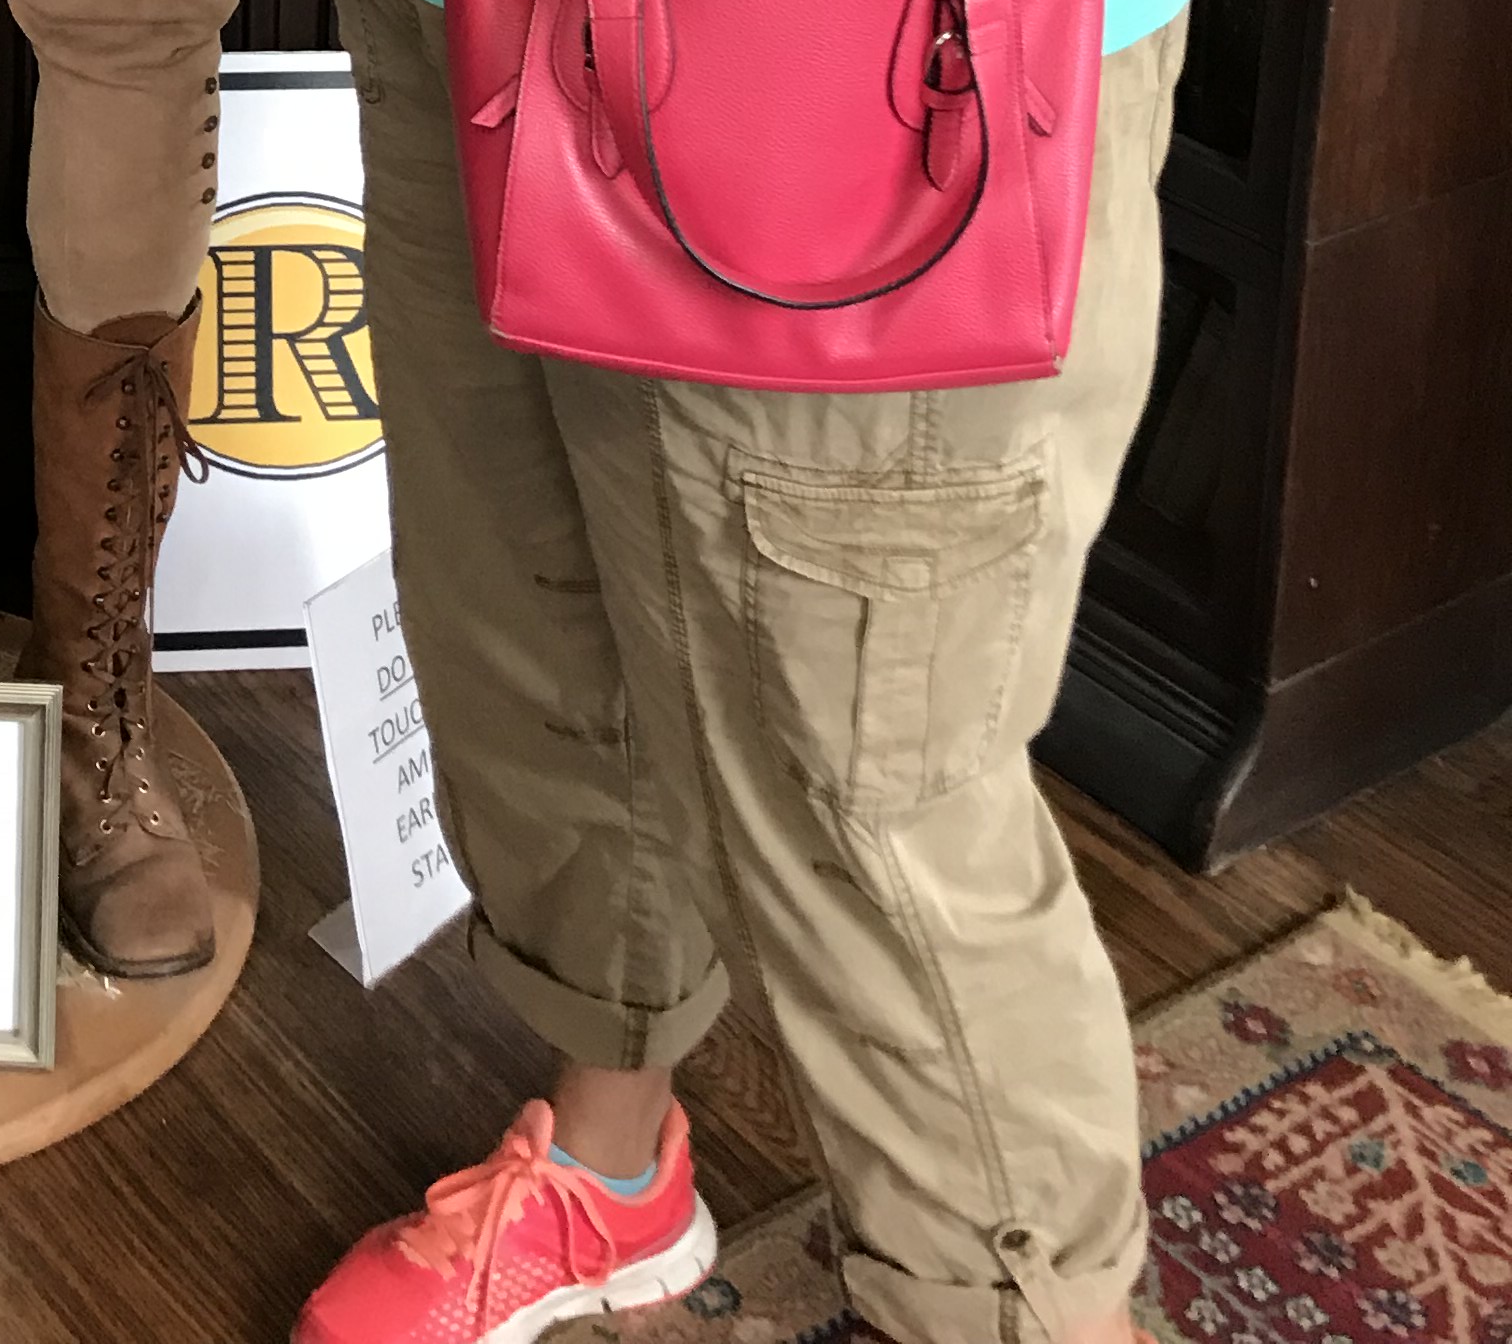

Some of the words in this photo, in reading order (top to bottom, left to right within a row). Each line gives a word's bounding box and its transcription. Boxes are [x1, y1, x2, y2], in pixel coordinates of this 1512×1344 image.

[371, 601, 401, 641] PLE
[377, 654, 406, 694] DO
[368, 698, 424, 754] TOUC
[411, 843, 449, 888] STA
